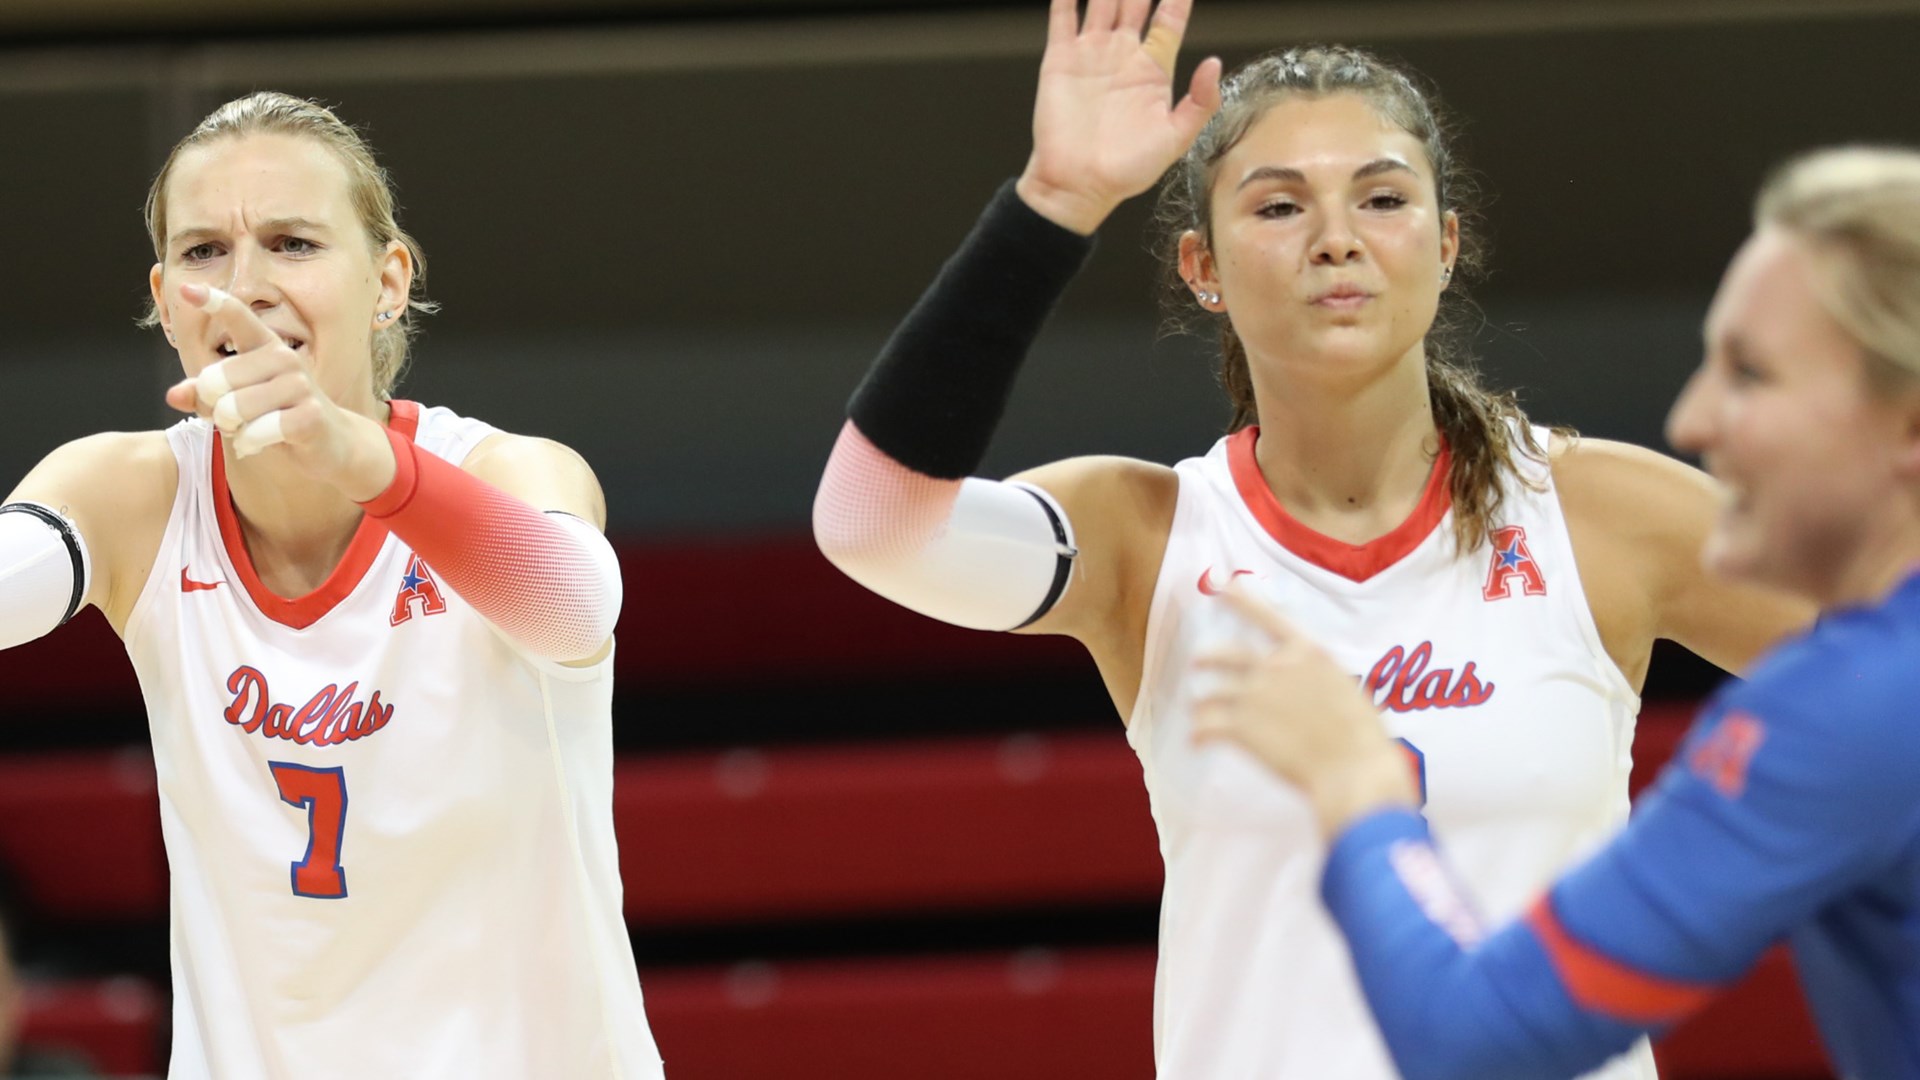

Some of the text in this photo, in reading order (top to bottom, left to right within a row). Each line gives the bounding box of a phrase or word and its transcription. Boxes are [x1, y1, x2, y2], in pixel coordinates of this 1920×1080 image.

[389, 550, 447, 627] A
[1482, 525, 1547, 602] A
[224, 665, 394, 746] Dallas
[1352, 640, 1495, 714] llas
[267, 760, 348, 900] 7
